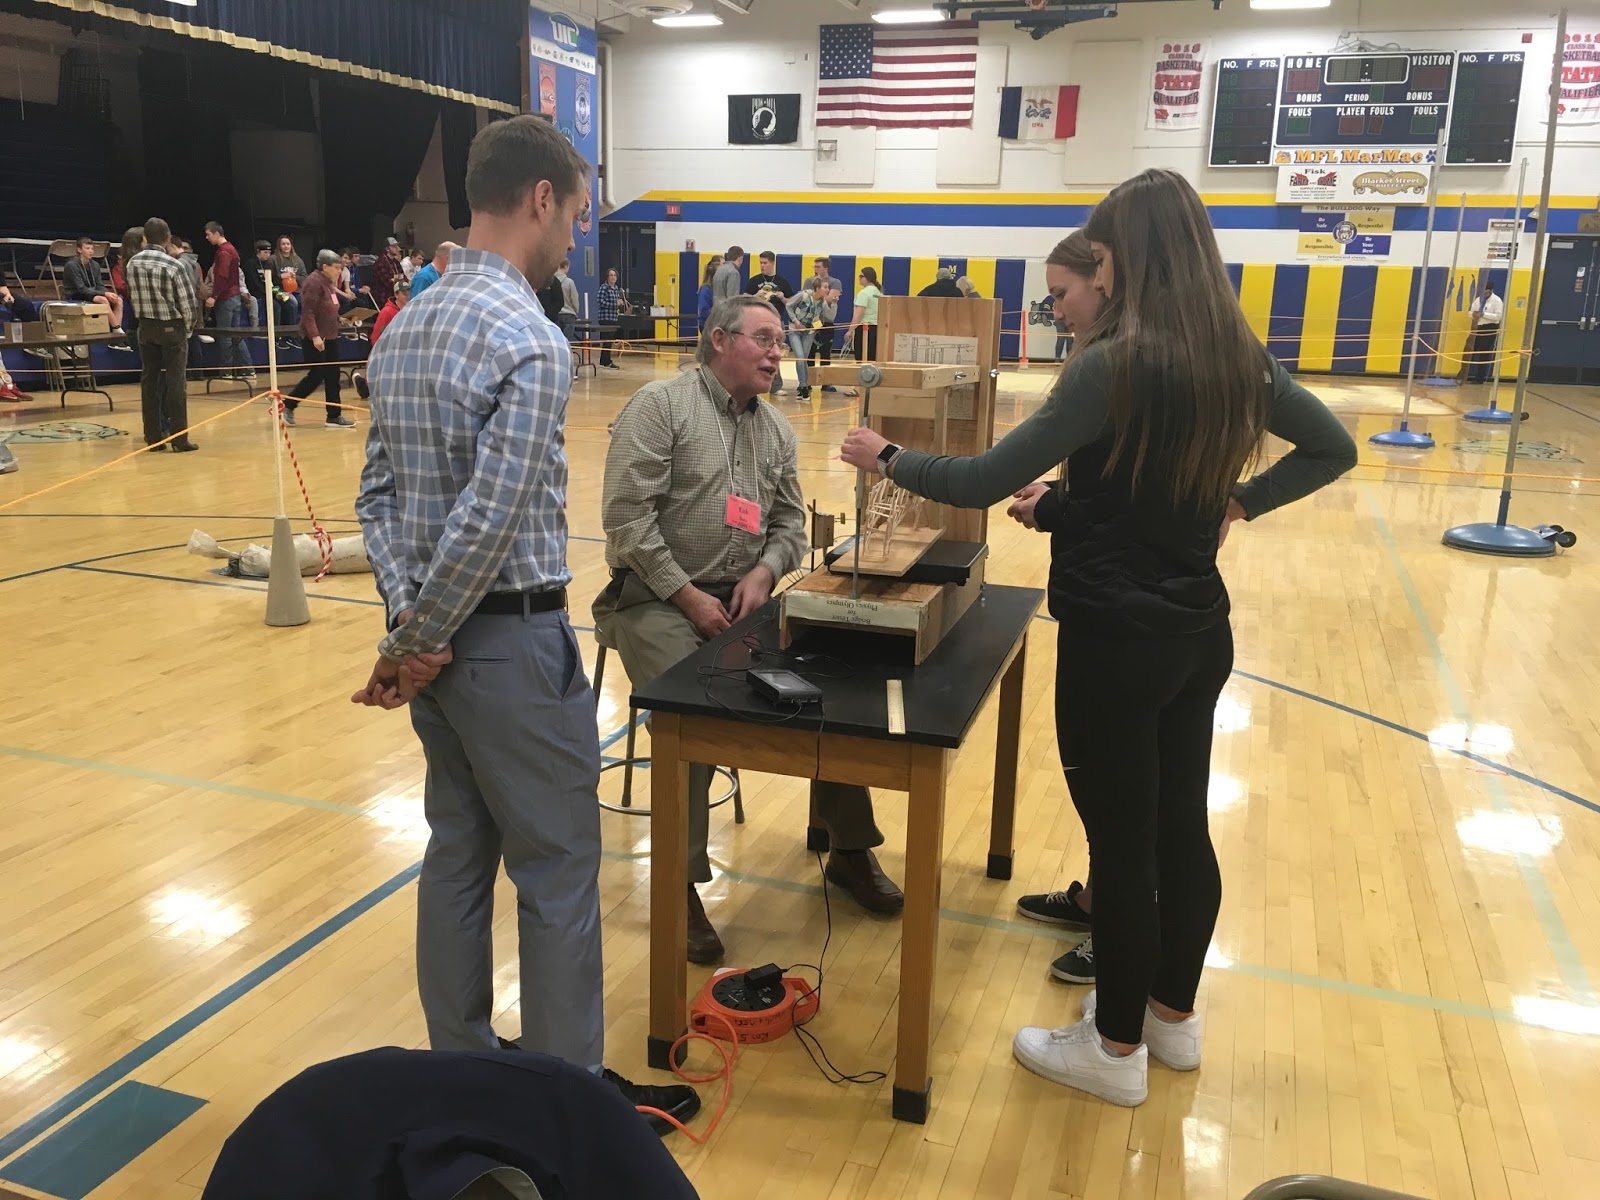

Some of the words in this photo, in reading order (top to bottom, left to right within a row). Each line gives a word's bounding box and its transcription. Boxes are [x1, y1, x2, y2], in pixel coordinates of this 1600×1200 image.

[1286, 57, 1323, 69] HOME
[1412, 54, 1452, 66] VISITOR
[1462, 54, 1479, 63] NO.
[1488, 54, 1495, 62] F
[1502, 54, 1523, 62] PTS.
[1156, 60, 1203, 73] BASKETBALL
[1223, 60, 1239, 69] NO.
[1247, 60, 1254, 68] F
[1259, 59, 1279, 68] PTS.
[1153, 90, 1200, 106] QUALIFIER
[1296, 93, 1322, 103] BONUS
[1344, 93, 1370, 102] PERIOD
[1406, 92, 1433, 101] BONUS
[1288, 107, 1312, 117] FOULS
[1336, 106, 1366, 116] PLAYER
[1369, 106, 1395, 115] FOULS
[1413, 106, 1439, 115] FOULS
[1293, 150, 1339, 164] MFL
[1340, 150, 1423, 164] MarMac
[1365, 205, 1381, 213] Way
[826, 600, 855, 609] Olympics
[855, 602, 878, 612] Physics
[831, 614, 850, 623] Tester
[850, 615, 871, 625] Bridge
